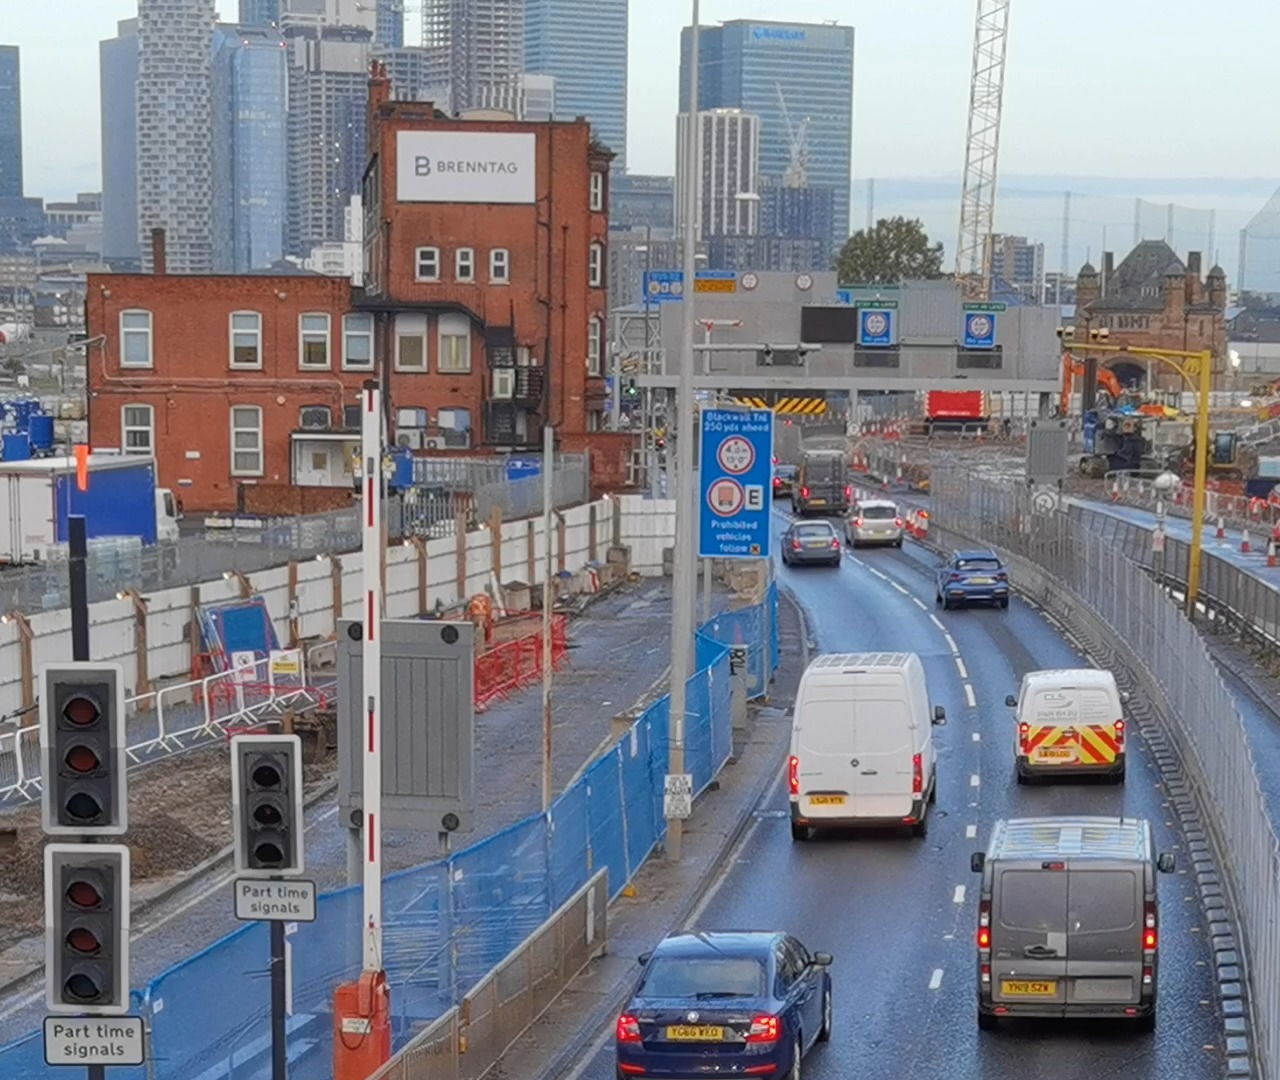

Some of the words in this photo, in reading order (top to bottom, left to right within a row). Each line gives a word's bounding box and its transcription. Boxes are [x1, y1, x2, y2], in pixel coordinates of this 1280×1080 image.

[436, 160, 518, 175] BRENNTAG
[748, 489, 760, 505] E
[710, 519, 758, 530] Prohibited
[242, 885, 272, 898] Part
[277, 886, 309, 900] time
[250, 901, 301, 916] signals
[53, 1024, 91, 1039] Part
[96, 1024, 135, 1039] time
[63, 1042, 125, 1059] signals
